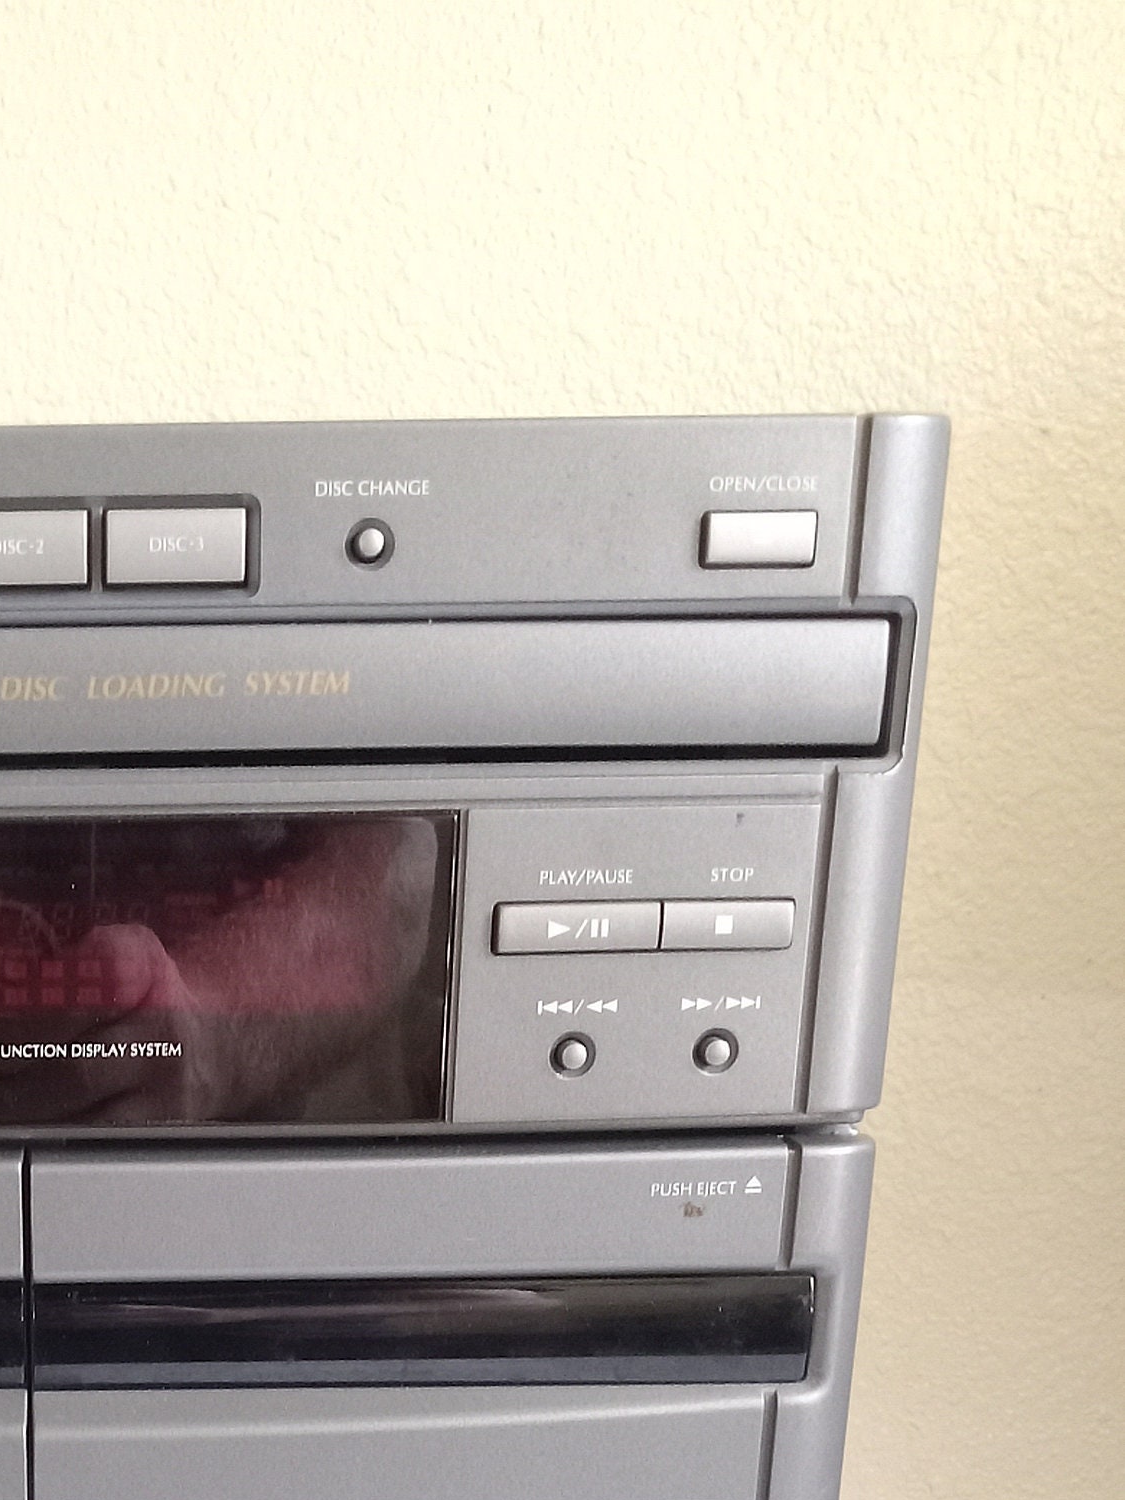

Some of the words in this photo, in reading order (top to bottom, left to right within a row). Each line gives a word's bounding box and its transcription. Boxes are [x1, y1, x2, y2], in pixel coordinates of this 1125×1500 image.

[314, 481, 354, 497] DISC
[358, 479, 430, 496] CHANGE
[709, 475, 818, 493] OPEN/CLOSE
[0, 676, 64, 700] DISC
[86, 672, 225, 700] LOADING
[245, 670, 351, 697] SYSTEM
[539, 869, 634, 886] PLAY/PAUSE
[711, 867, 754, 883] STOP
[71, 1042, 128, 1059] DISPLAY
[129, 1041, 183, 1058] SYSTEM
[651, 1182, 692, 1198] PUSH
[697, 1180, 737, 1197] EJECT
